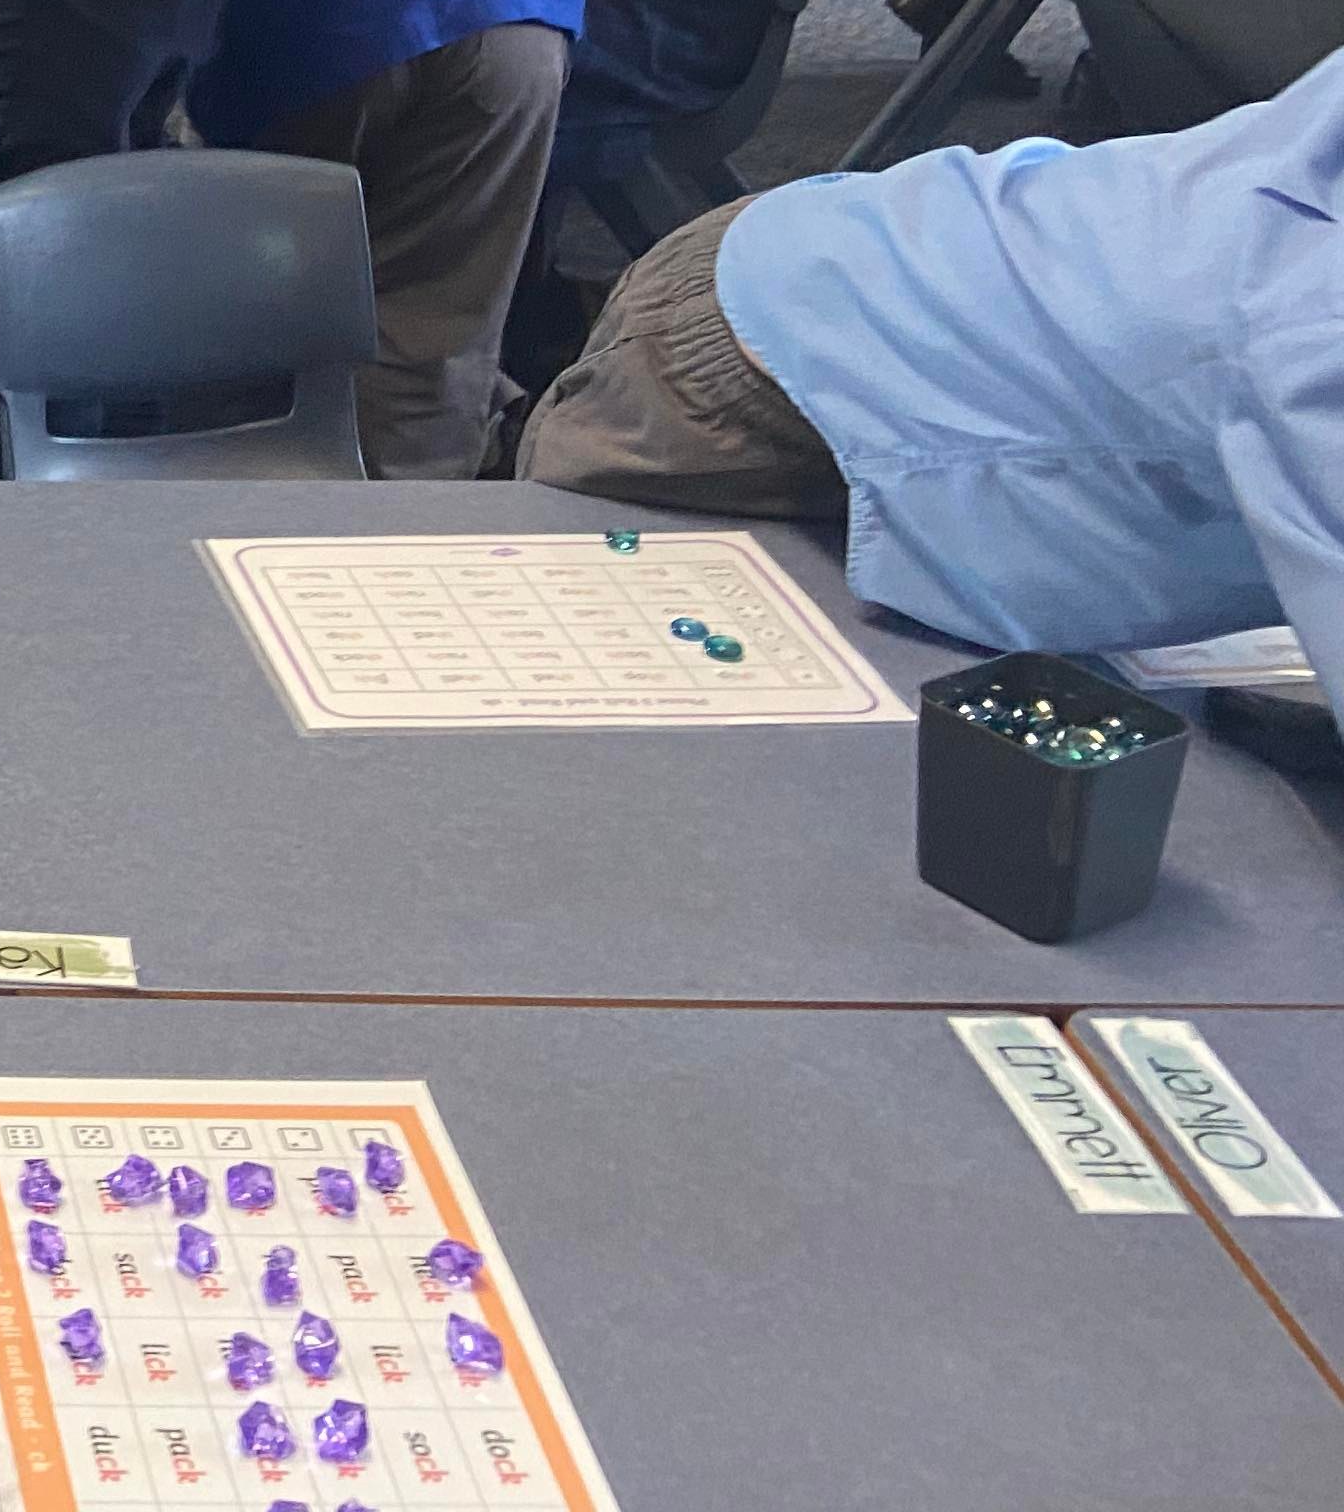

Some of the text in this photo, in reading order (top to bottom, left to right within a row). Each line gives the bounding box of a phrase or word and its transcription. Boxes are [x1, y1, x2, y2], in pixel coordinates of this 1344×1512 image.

[996, 1045, 1153, 1180] Emmett
[1146, 1055, 1268, 1170] Oliver
[115, 1252, 151, 1299] sack
[328, 1255, 379, 1303] pack
[4, 1344, 31, 1378] and
[141, 1343, 177, 1382] lick
[371, 1345, 410, 1384] lick
[15, 1383, 40, 1431] Read
[26, 1450, 51, 1472] ck
[89, 1424, 128, 1482] duck
[156, 1428, 207, 1484] pack
[403, 1431, 449, 1483] sock
[481, 1429, 528, 1484] dock
